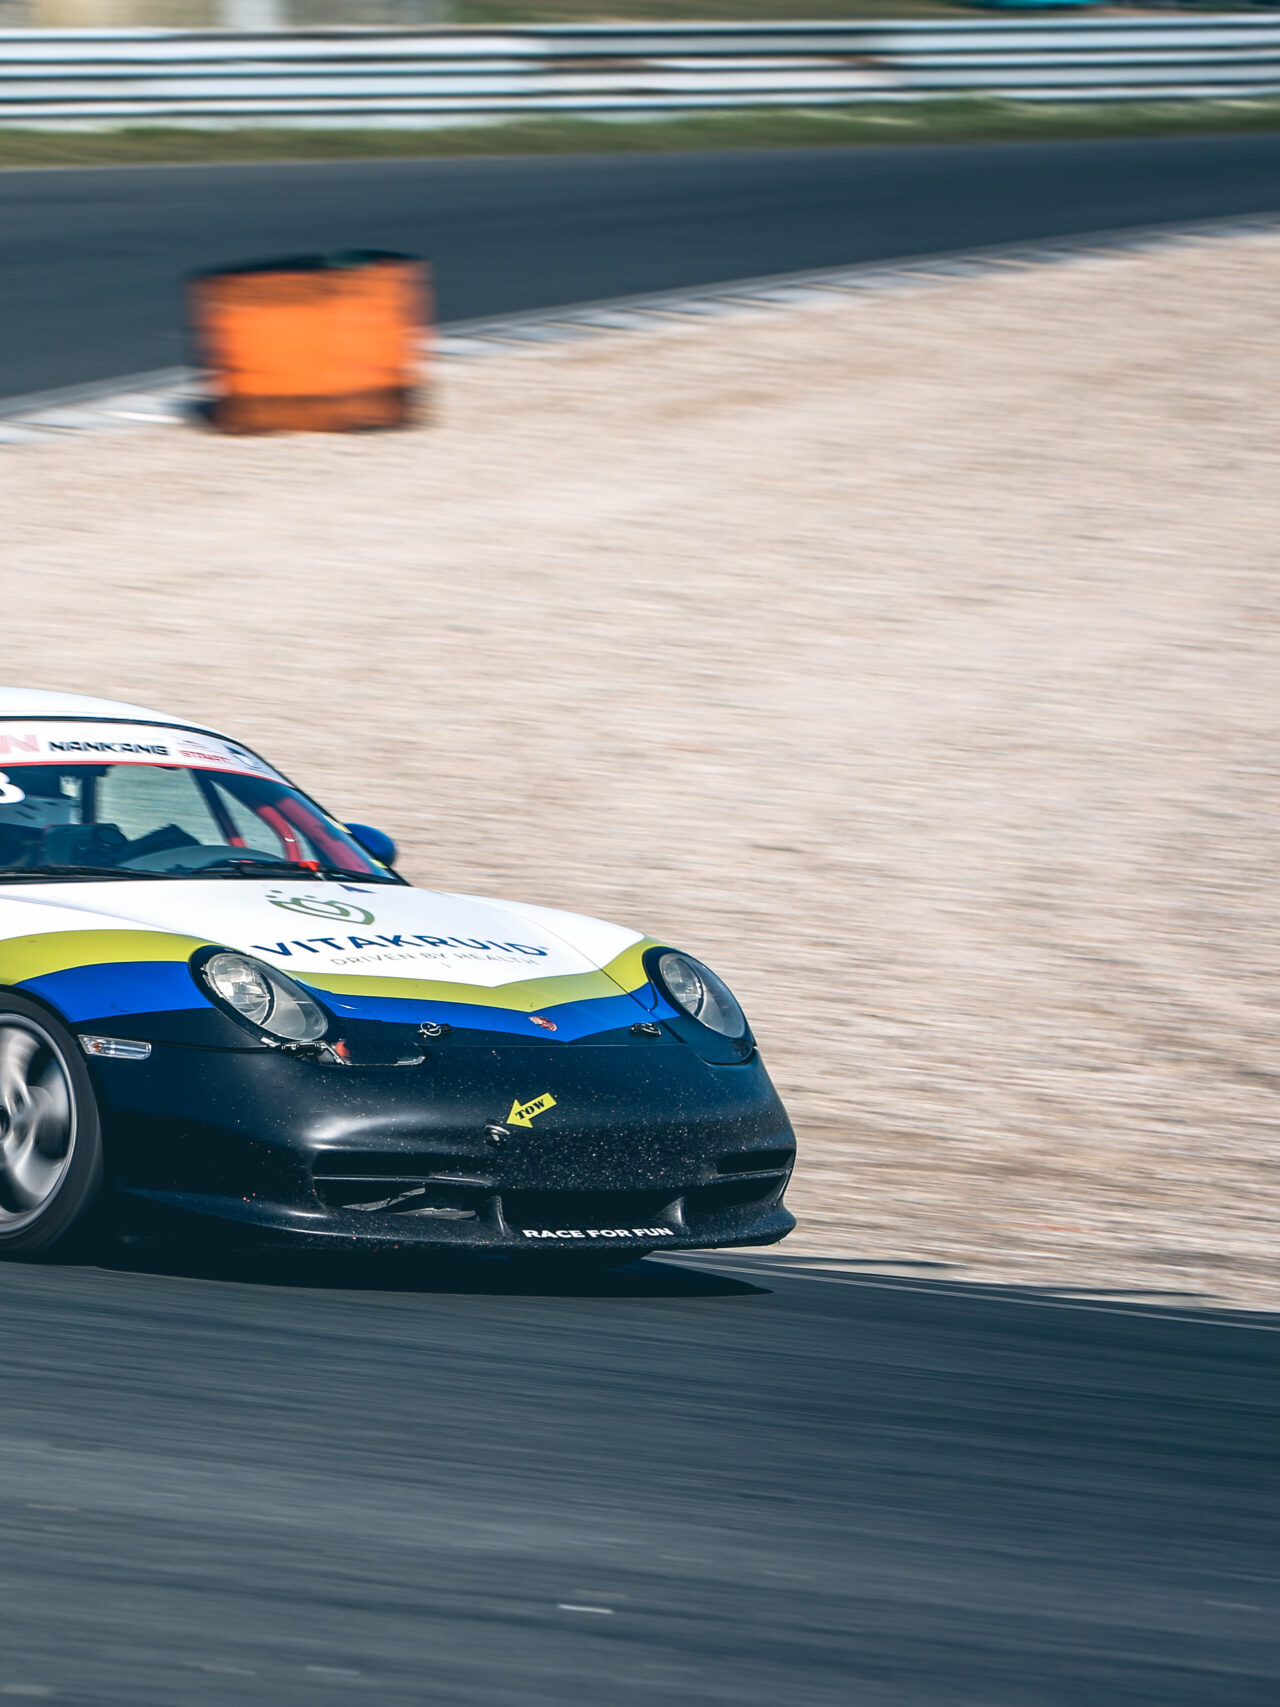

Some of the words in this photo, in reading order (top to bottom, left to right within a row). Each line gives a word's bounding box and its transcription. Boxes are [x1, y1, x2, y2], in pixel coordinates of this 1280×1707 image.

[48, 741, 169, 756] NANKANG
[250, 934, 548, 957] VITAKRUID
[329, 952, 414, 966] DRIVEN
[458, 952, 539, 967] HEALTH
[515, 1099, 545, 1119] TOW
[522, 1229, 586, 1238] RACE
[587, 1229, 631, 1238] FOR
[632, 1227, 674, 1237] FUN
